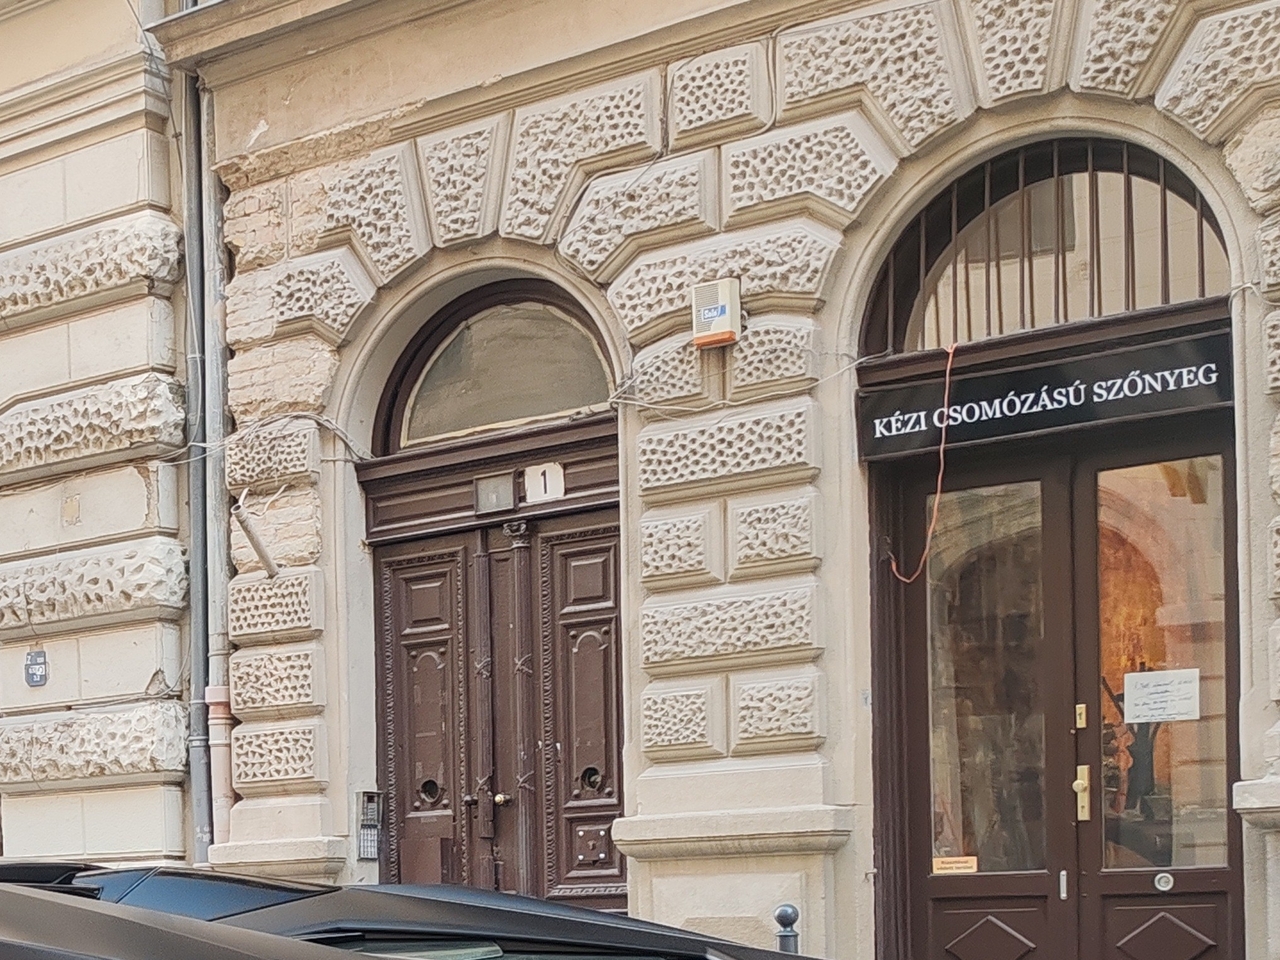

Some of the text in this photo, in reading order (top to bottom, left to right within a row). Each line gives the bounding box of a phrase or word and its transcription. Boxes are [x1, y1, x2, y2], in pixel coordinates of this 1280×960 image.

[873, 363, 1219, 438] KÉZI CSOMÓZÁSÚ SZŐNYEG
[540, 469, 548, 495] 1
